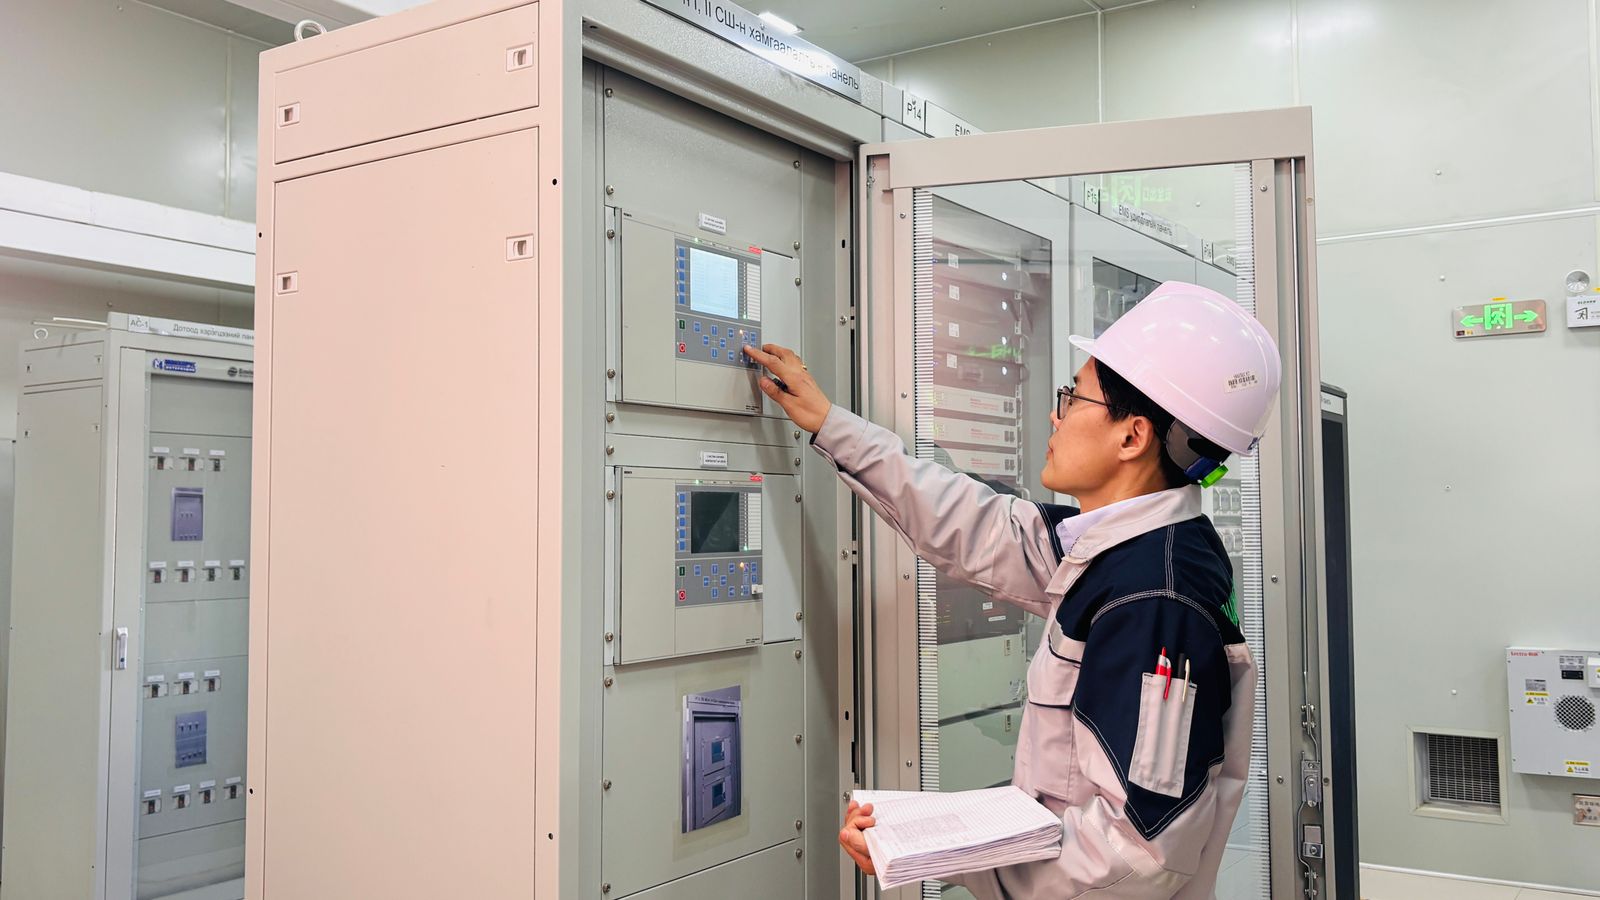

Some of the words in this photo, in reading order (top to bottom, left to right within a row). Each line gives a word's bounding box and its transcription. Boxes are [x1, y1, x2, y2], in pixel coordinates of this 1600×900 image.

[715, 6, 746, 35] СШ-н
[906, 102, 922, 121] P14
[173, 323, 199, 334] Дотоод
